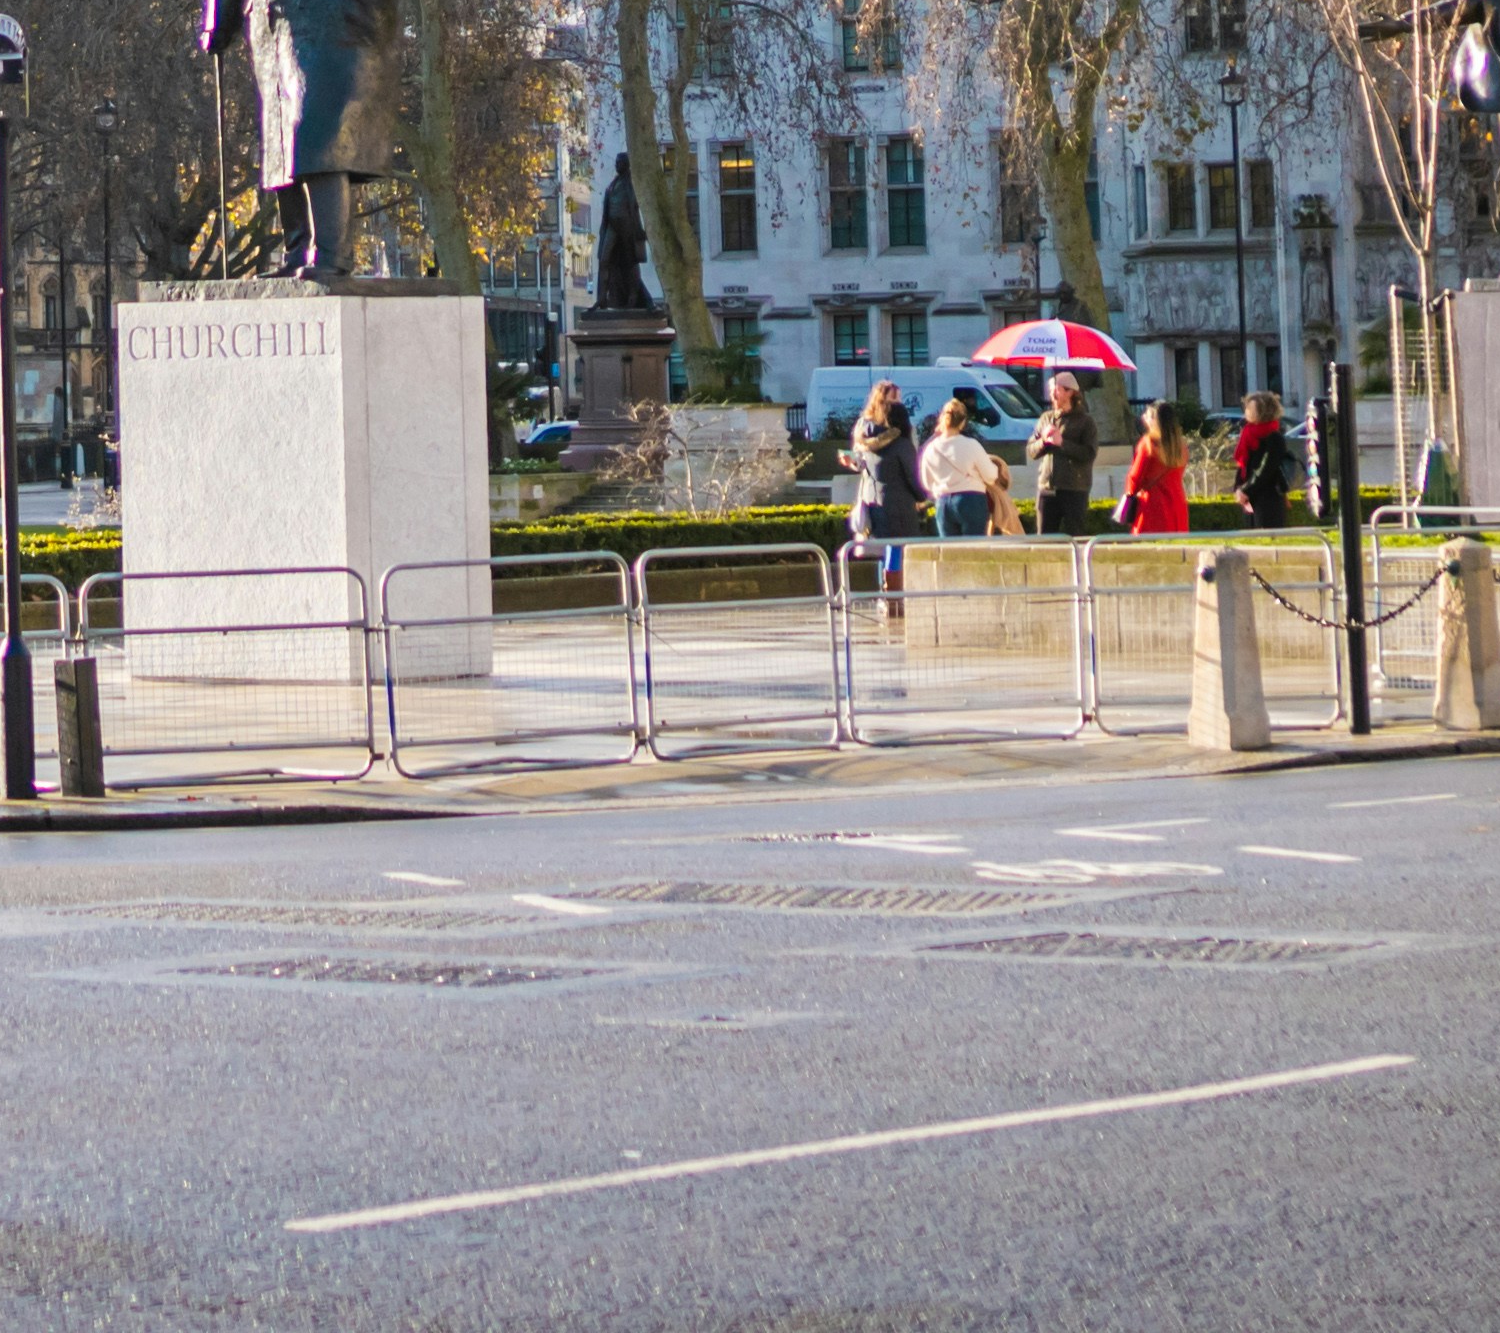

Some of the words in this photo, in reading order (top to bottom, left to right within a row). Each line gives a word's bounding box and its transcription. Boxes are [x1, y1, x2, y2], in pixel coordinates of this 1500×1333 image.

[128, 321, 336, 361] CHURCHILL
[1027, 337, 1057, 345] TOUR
[1022, 346, 1056, 354] GUIDE
